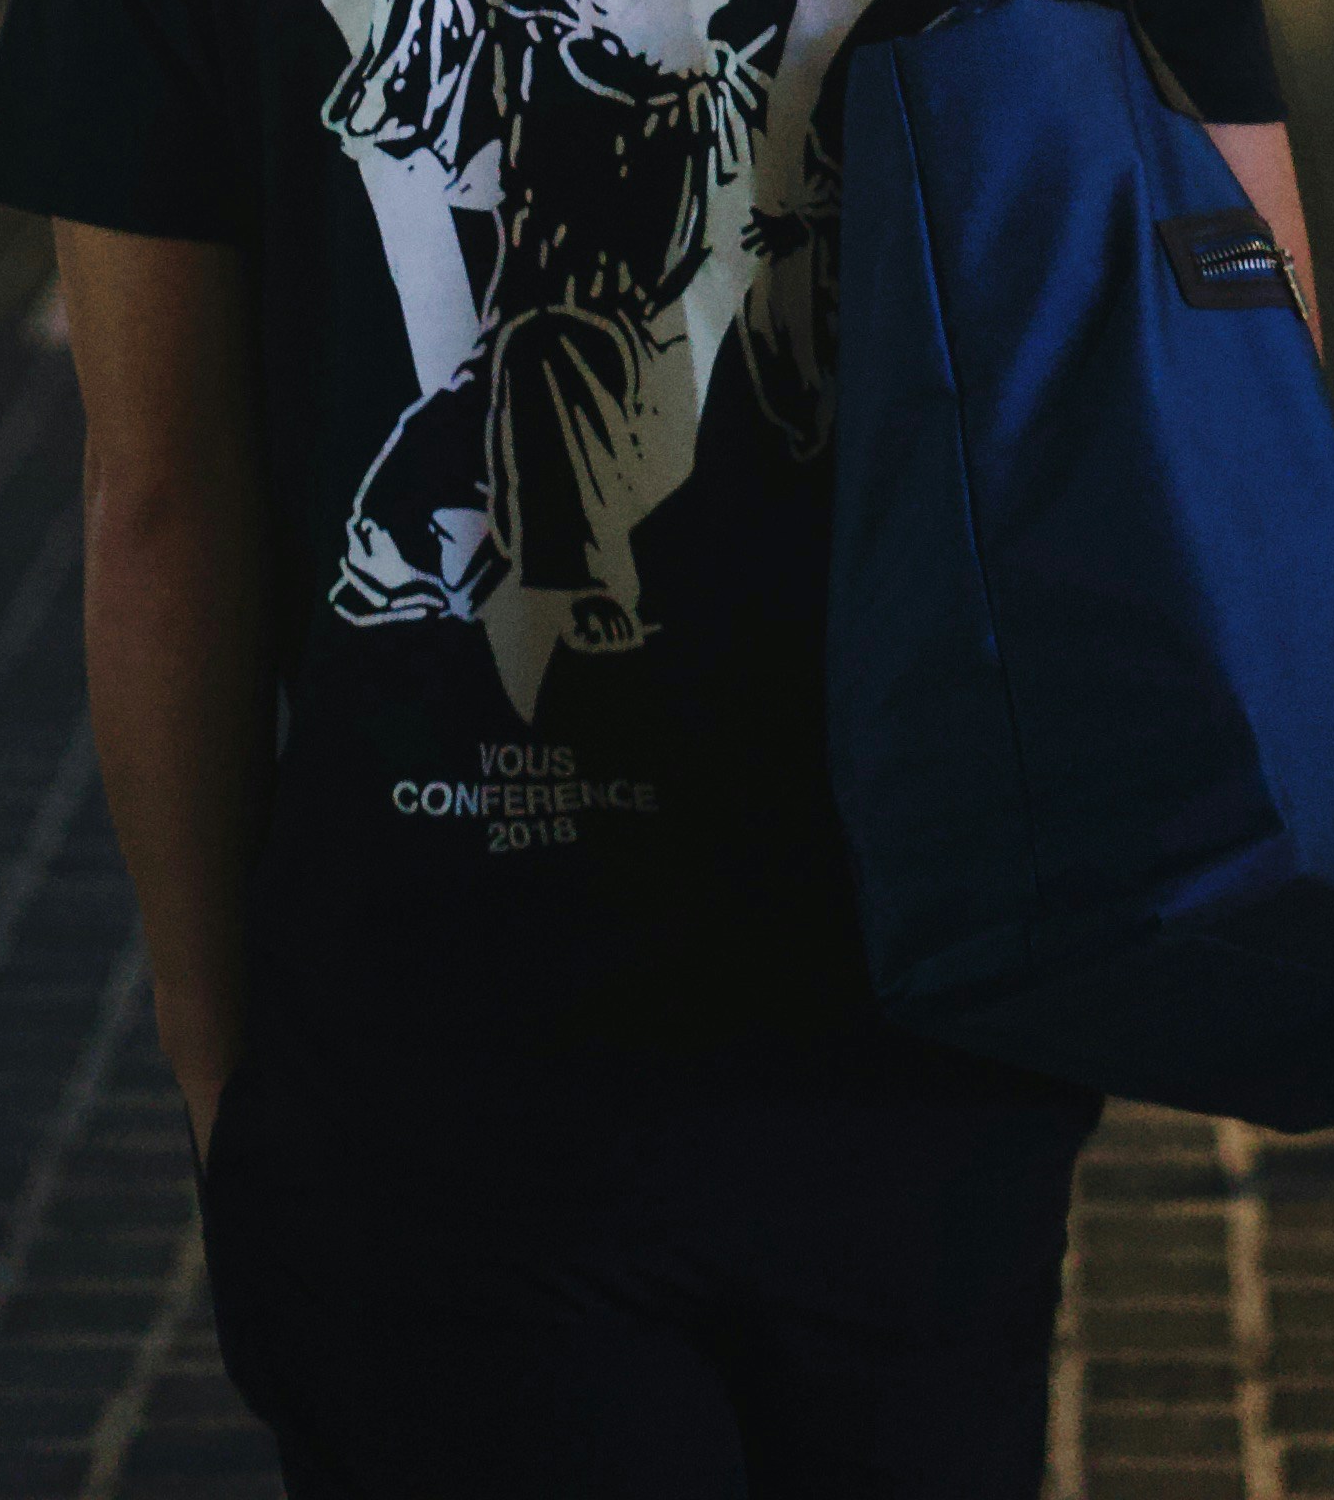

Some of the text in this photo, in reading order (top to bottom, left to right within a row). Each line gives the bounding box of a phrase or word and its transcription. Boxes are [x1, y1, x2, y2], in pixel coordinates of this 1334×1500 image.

[479, 740, 576, 779] VOUS
[391, 778, 660, 818] CONFERENCE
[486, 815, 578, 853] 2018
